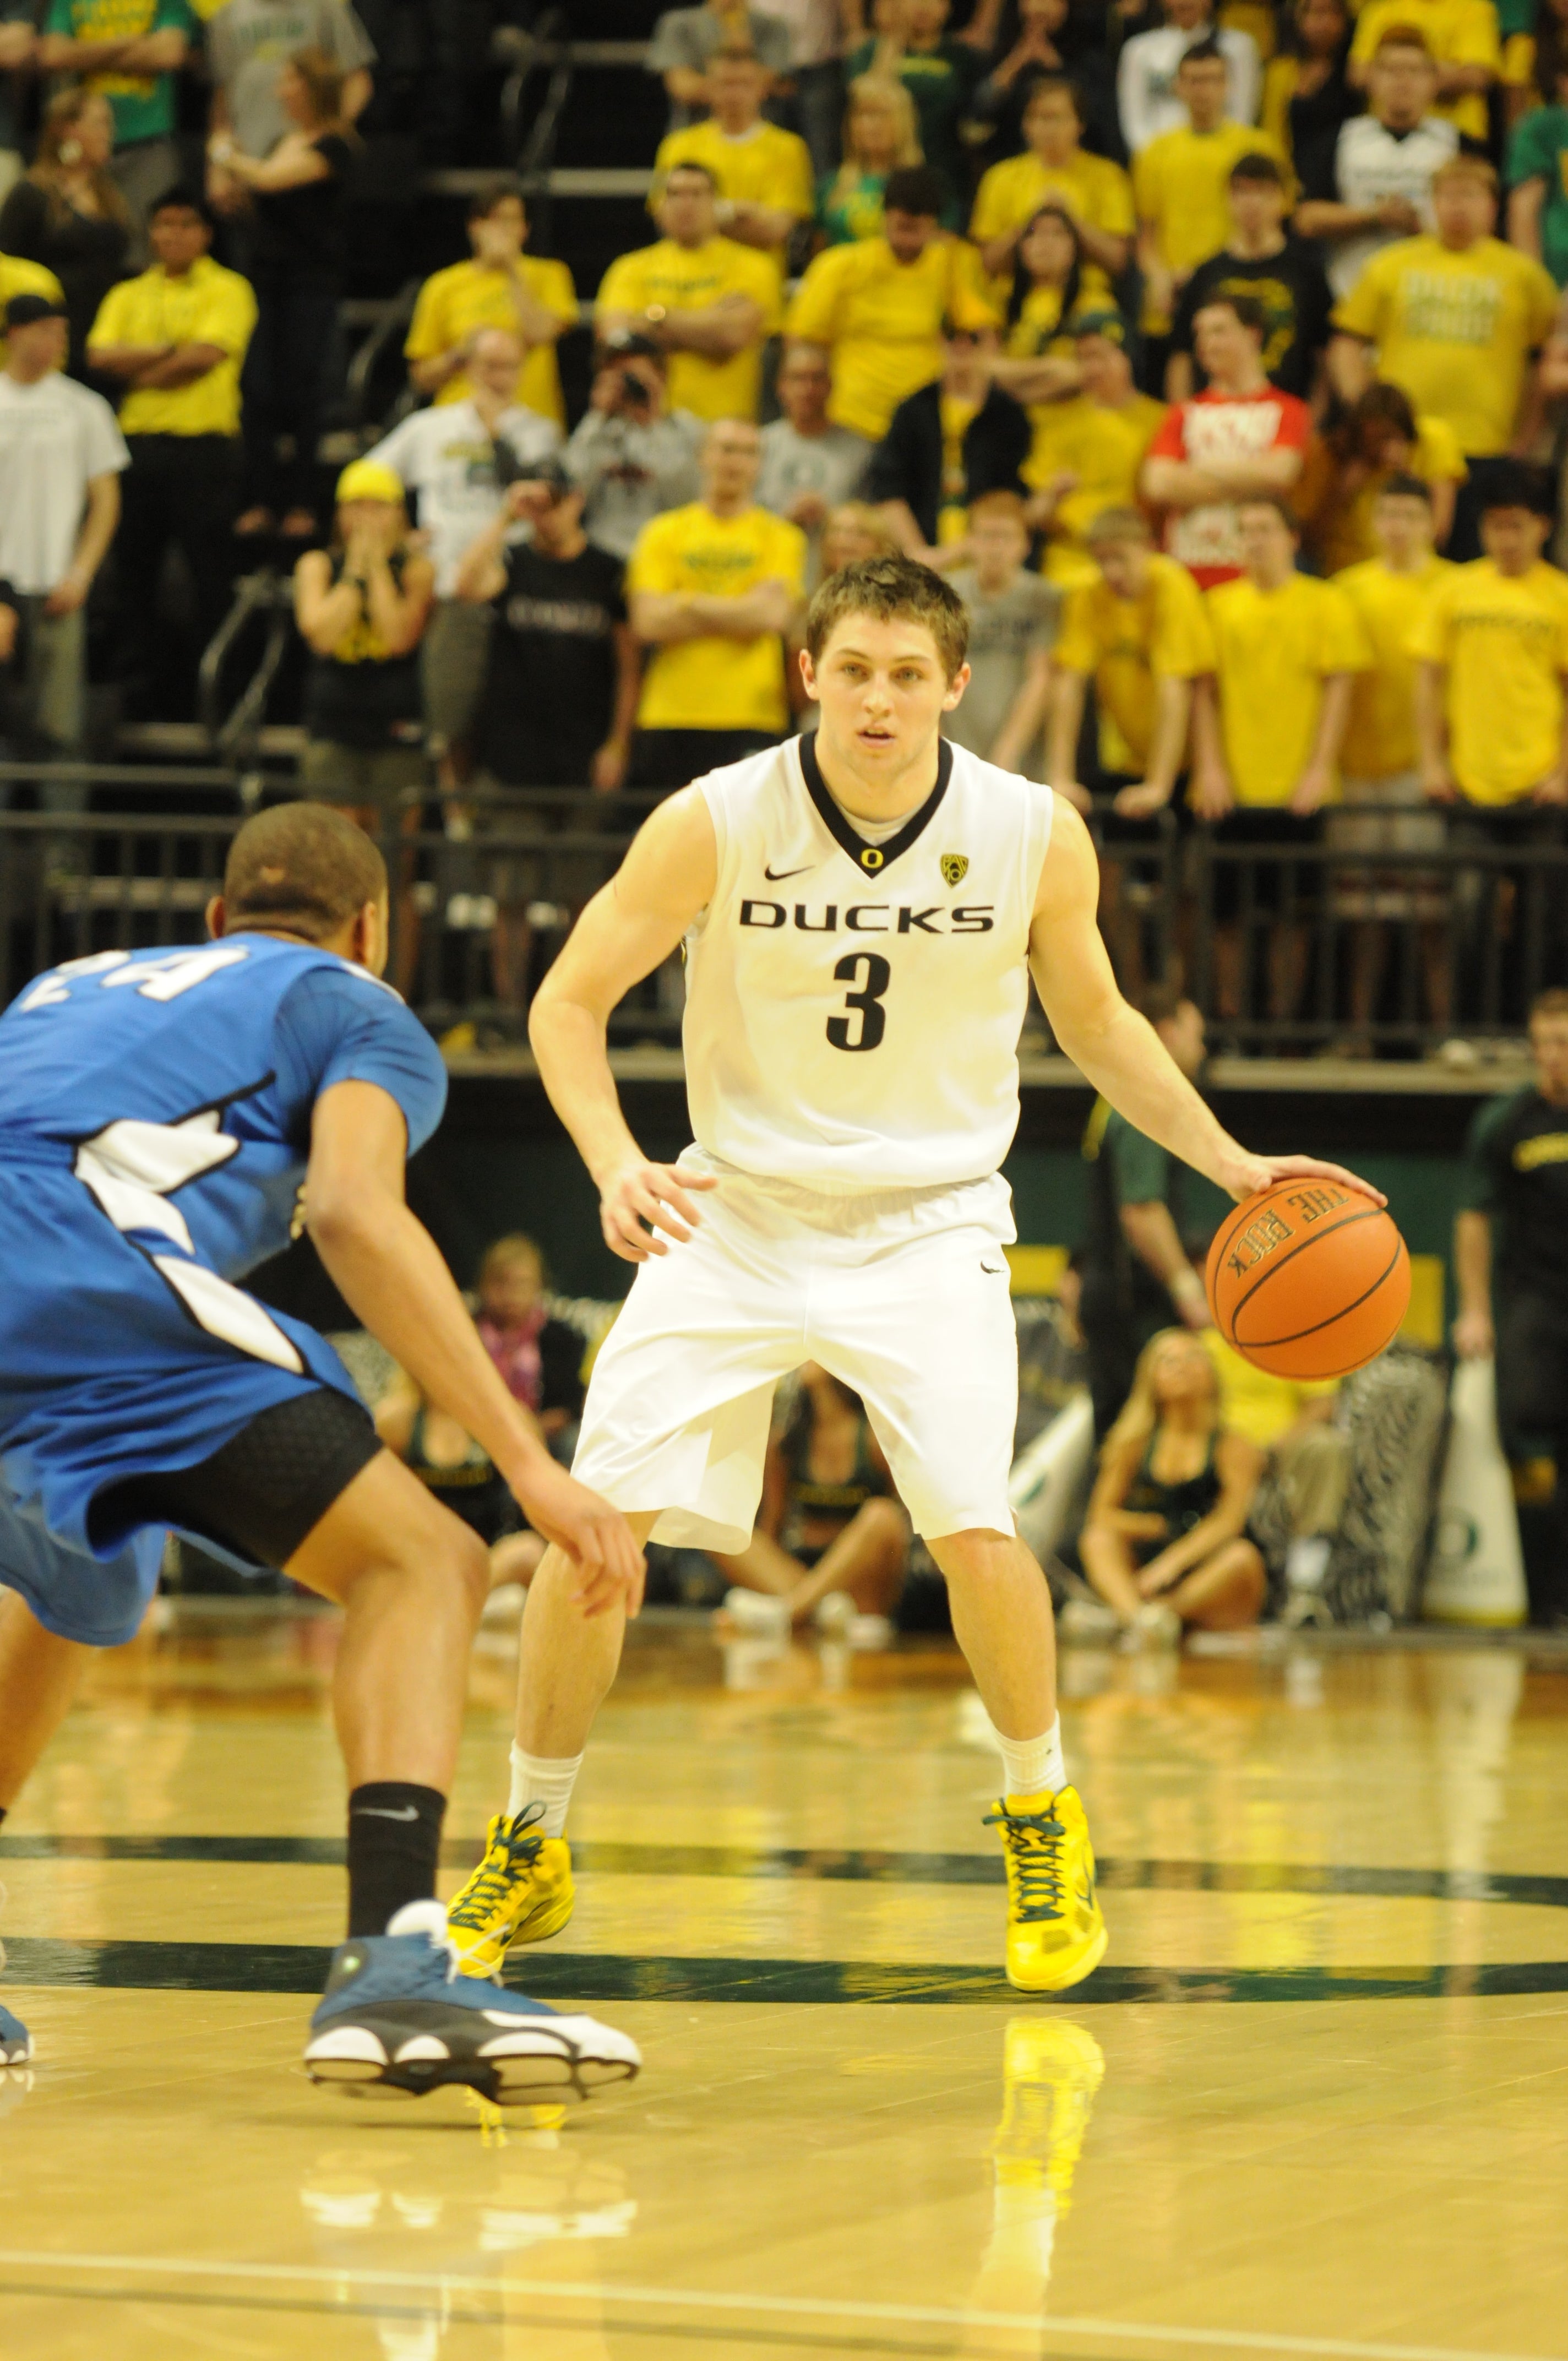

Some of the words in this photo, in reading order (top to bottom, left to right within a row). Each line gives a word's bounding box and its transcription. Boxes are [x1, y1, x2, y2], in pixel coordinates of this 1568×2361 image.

[861, 848, 883, 869] O
[739, 900, 994, 934] DUCKS
[826, 952, 891, 1052] 3
[1287, 1188, 1350, 1224] THE
[1227, 1208, 1296, 1279] ROCK
